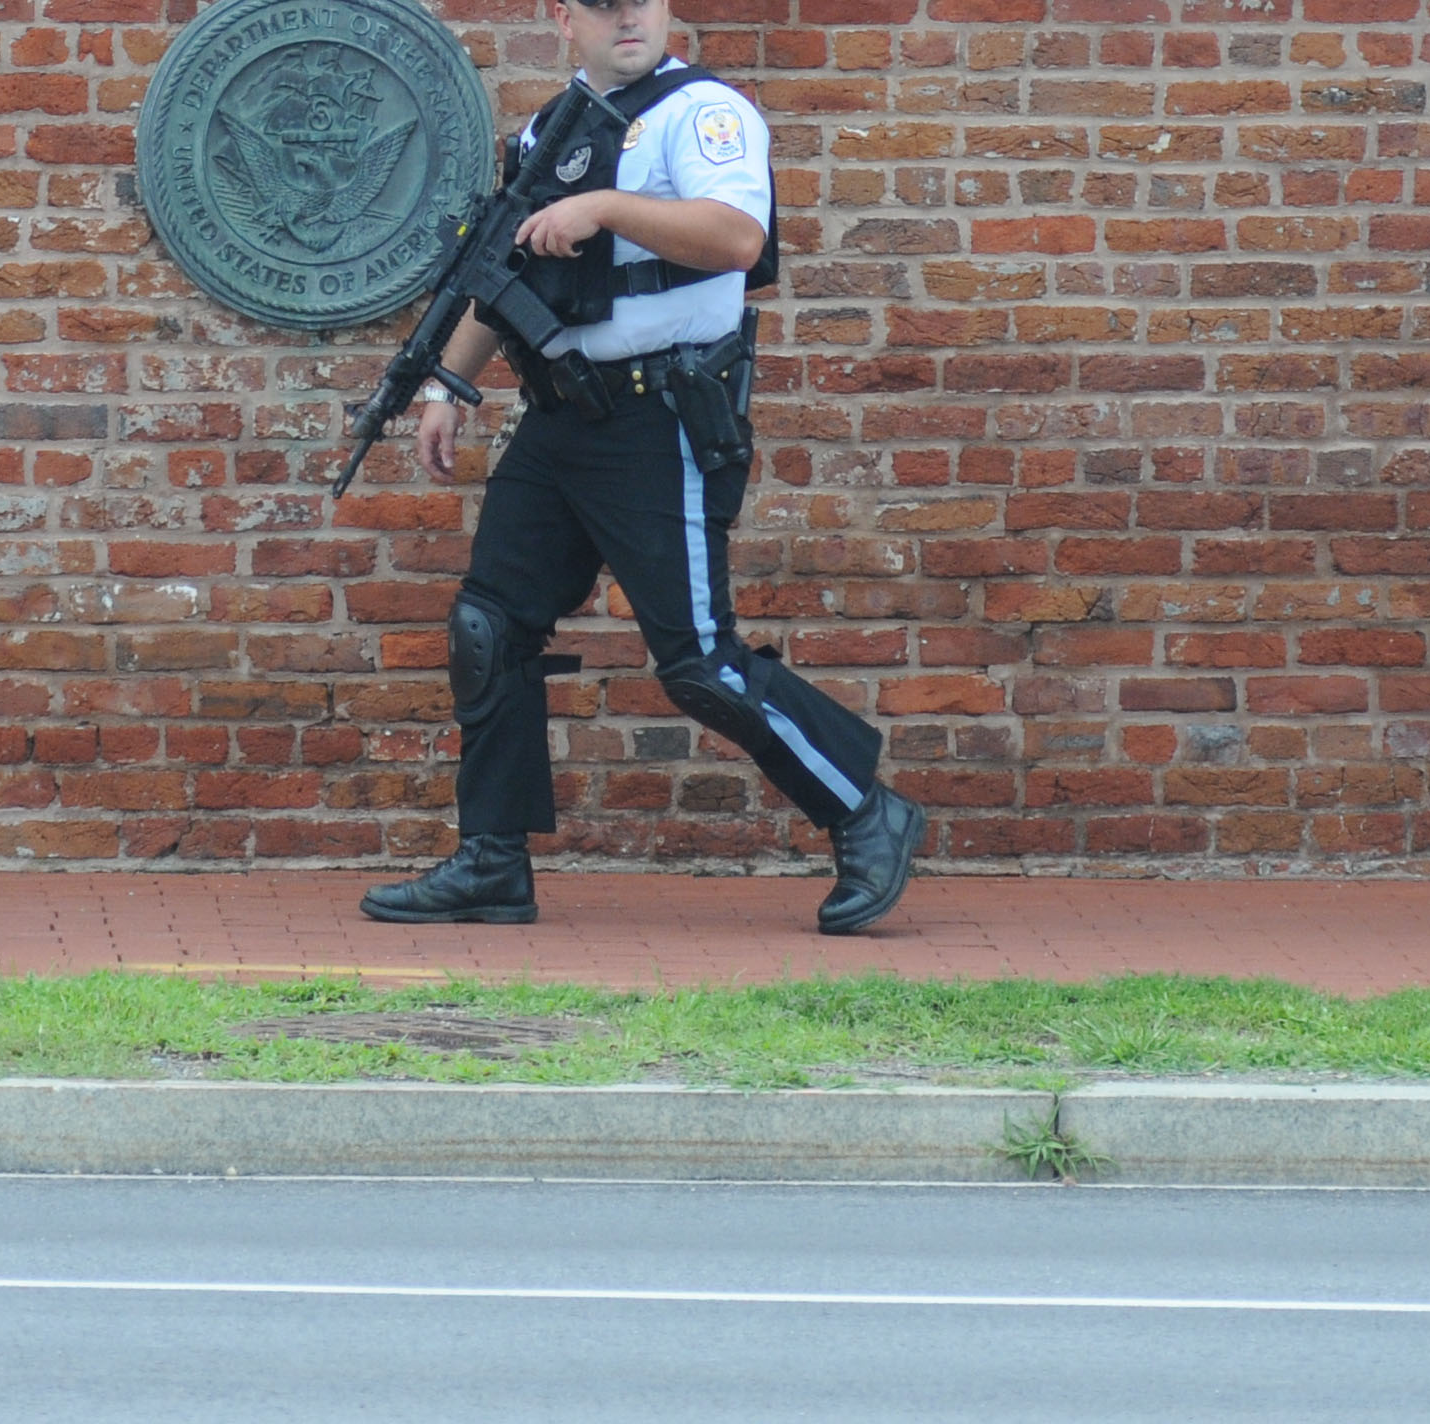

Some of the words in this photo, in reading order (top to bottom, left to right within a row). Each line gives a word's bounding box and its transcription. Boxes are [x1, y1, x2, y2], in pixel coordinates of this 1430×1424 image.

[182, 7, 340, 110] DEPARTMENT
[351, 14, 390, 42] OF
[390, 33, 435, 80] THE
[426, 80, 462, 162] NAVY
[172, 145, 219, 242] UNITED
[215, 242, 308, 296] STATES
[318, 271, 355, 297] OF
